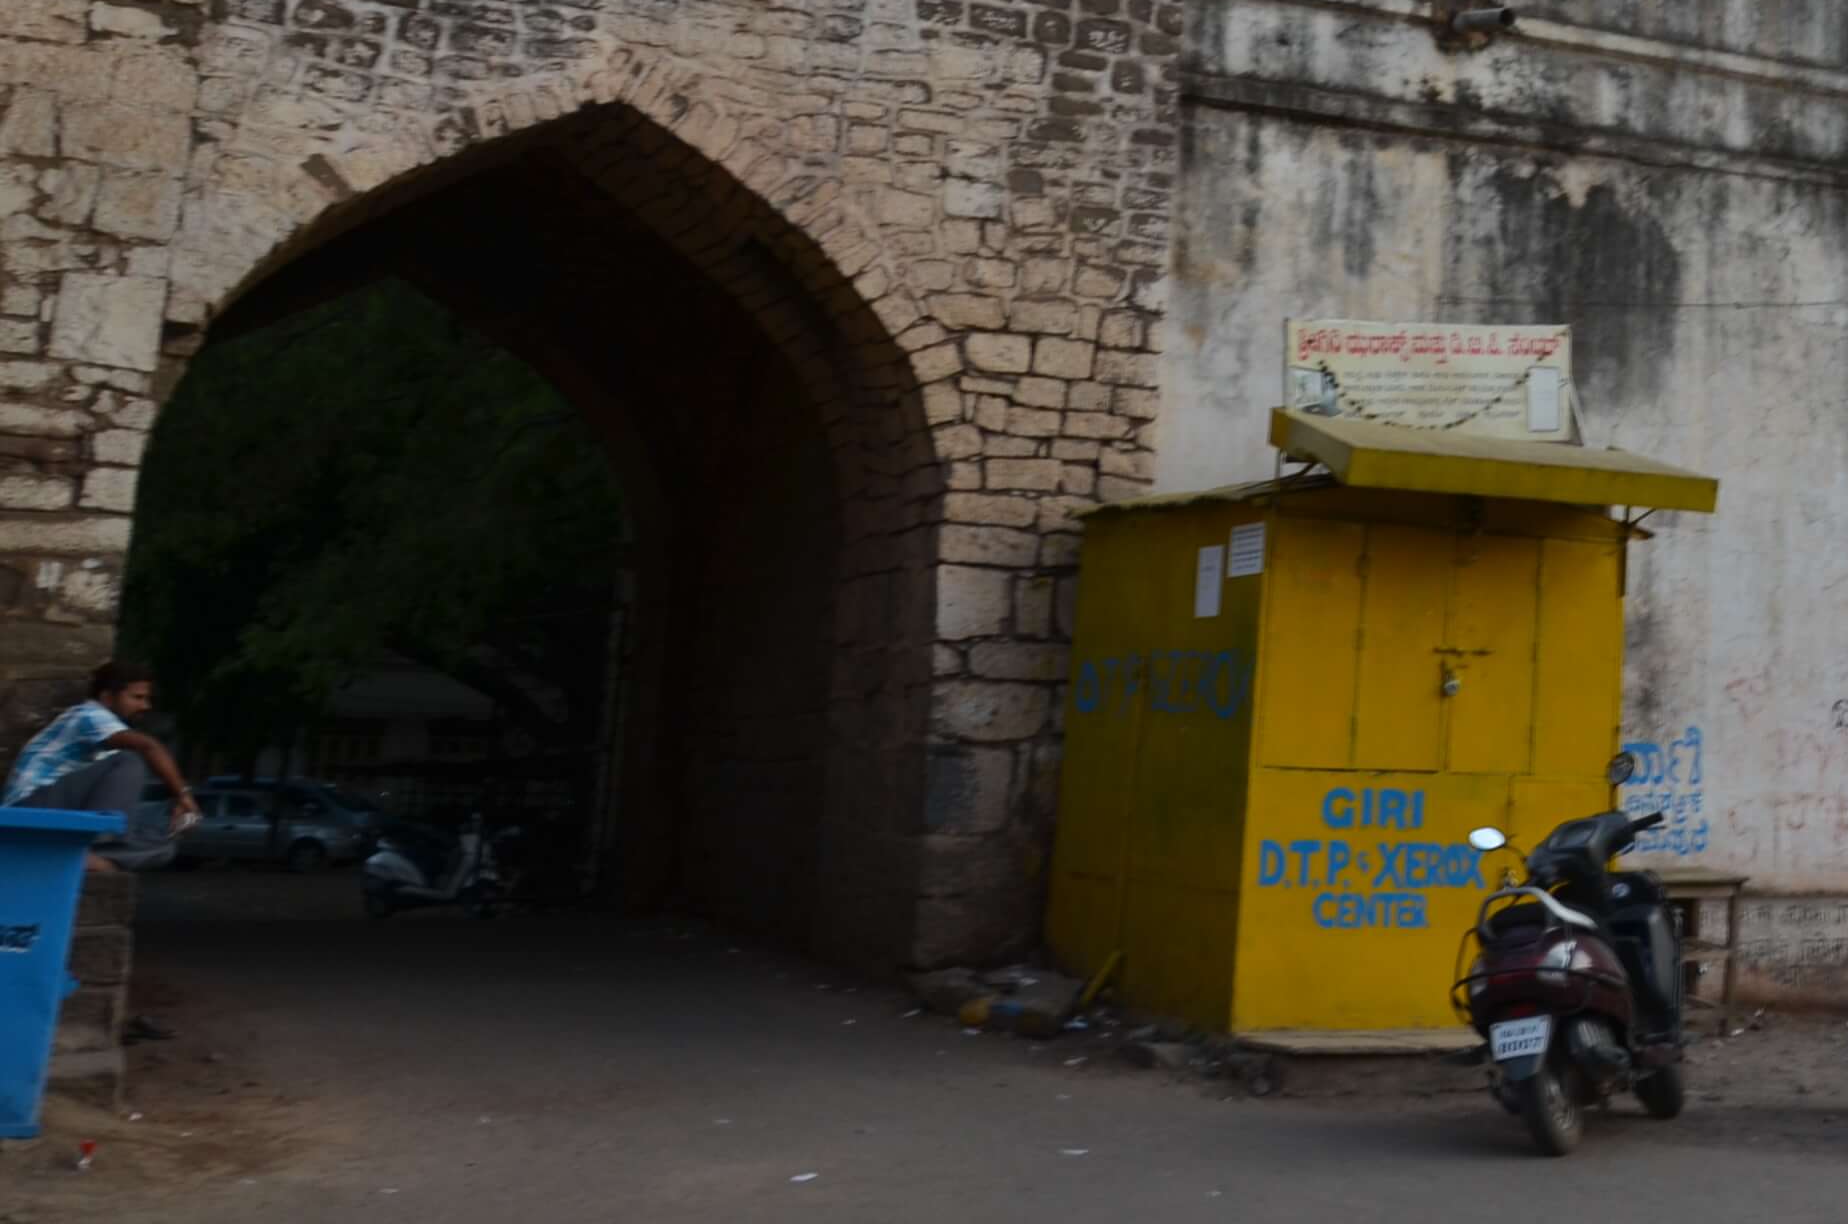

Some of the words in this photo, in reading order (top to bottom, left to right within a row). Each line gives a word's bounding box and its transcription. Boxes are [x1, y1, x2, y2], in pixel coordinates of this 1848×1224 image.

[1322, 786, 1426, 829] GIRI
[1371, 841, 1487, 889] XEROX
[1312, 892, 1430, 929] CENTER
